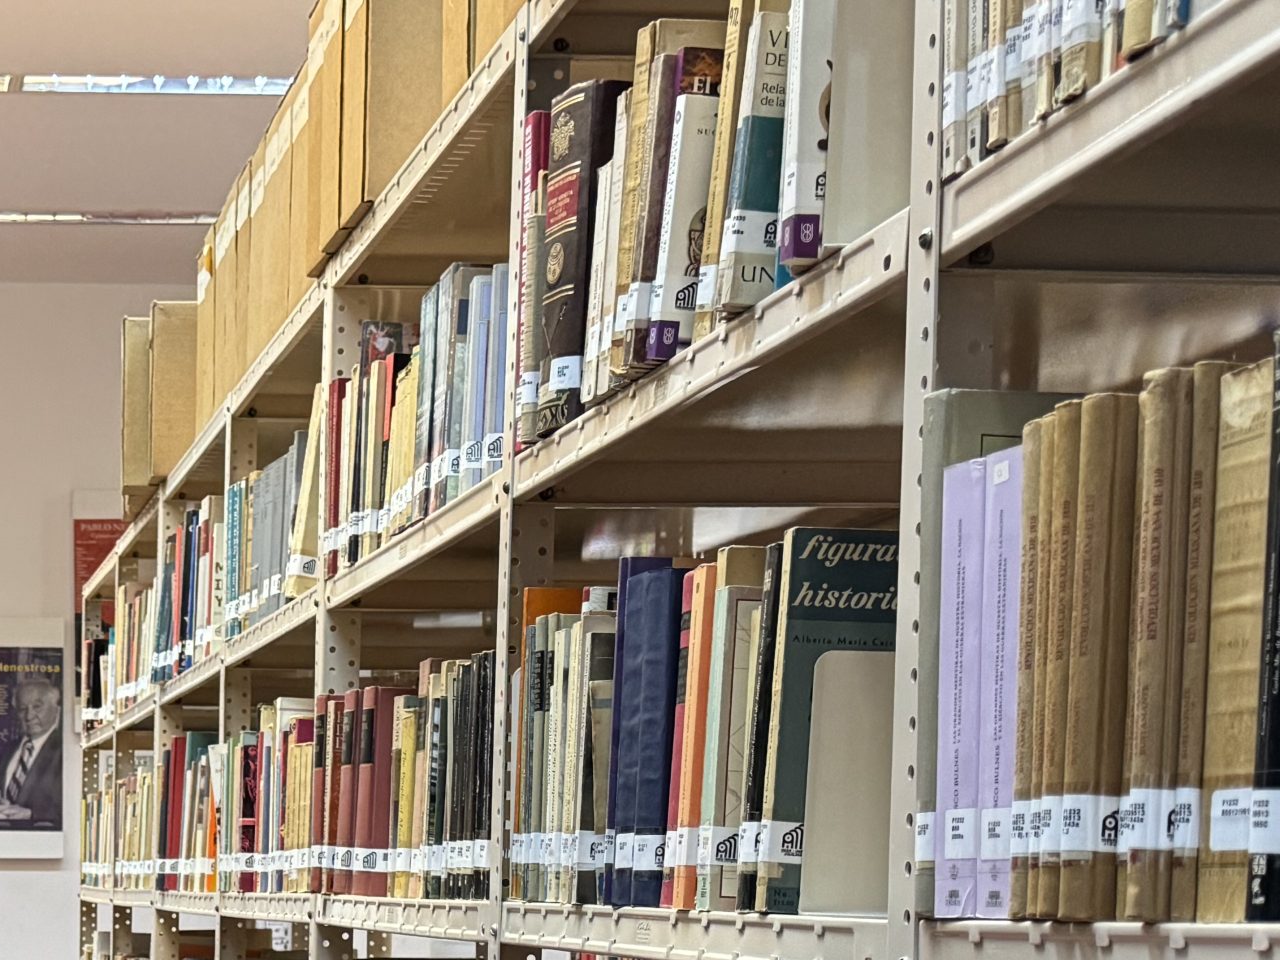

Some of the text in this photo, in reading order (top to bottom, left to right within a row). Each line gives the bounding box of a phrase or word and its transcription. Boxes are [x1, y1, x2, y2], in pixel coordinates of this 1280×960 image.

[693, 76, 711, 94] El
[760, 96, 785, 108] de la
[799, 534, 899, 567] figura
